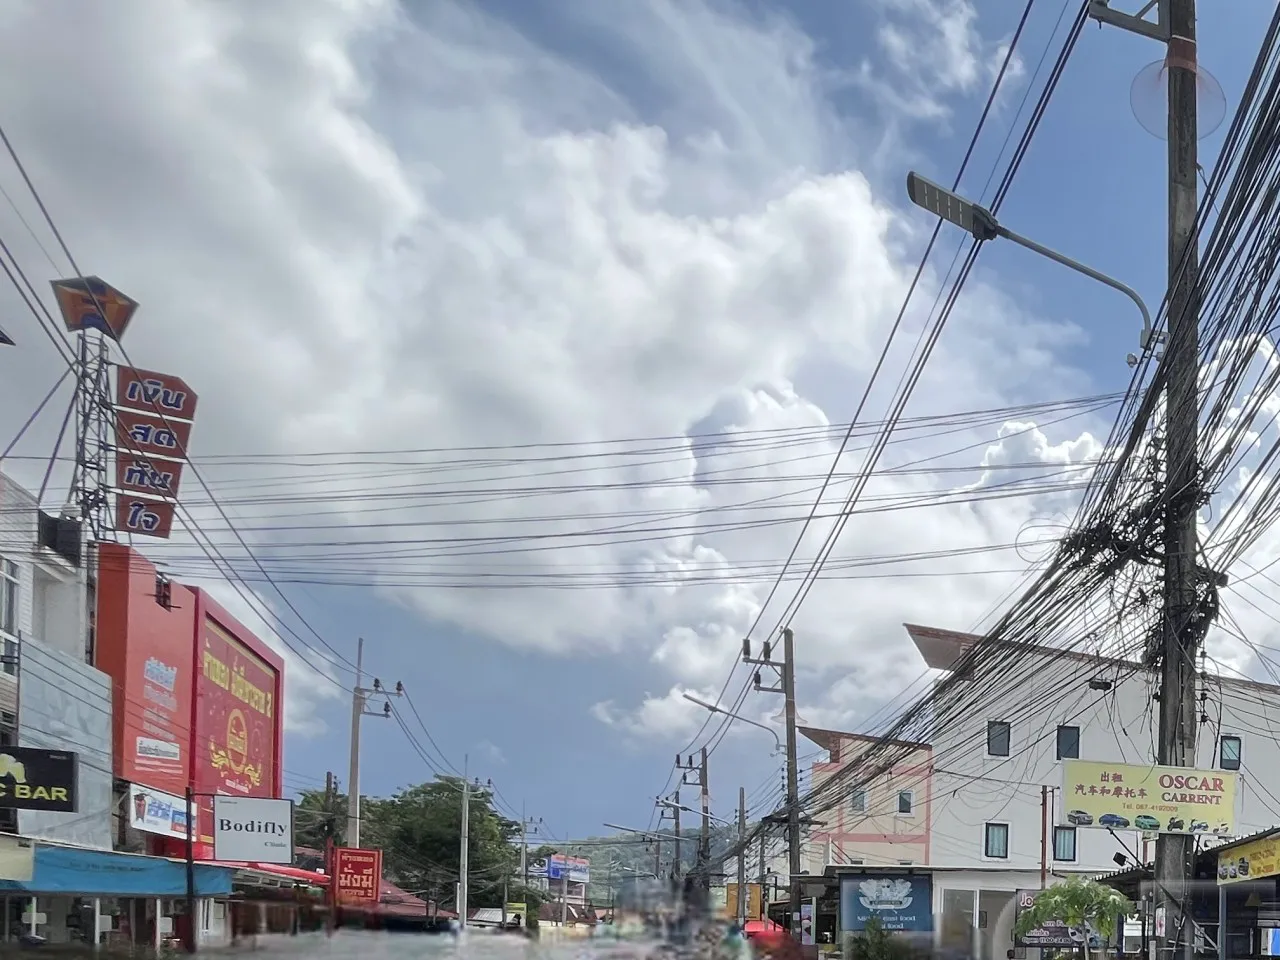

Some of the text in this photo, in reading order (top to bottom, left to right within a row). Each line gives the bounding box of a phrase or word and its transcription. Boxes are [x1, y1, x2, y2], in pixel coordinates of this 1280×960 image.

[126, 379, 186, 411] เงิน
[130, 423, 177, 449] สด
[127, 501, 160, 531] ใจ
[1100, 771, 1124, 783] 出租
[1159, 774, 1225, 792] OSCAR
[15, 784, 68, 802] BAR
[1075, 783, 1148, 799] 汽车和摩托车
[1161, 792, 1222, 805] CARRENT
[219, 818, 288, 837] Bodifly
